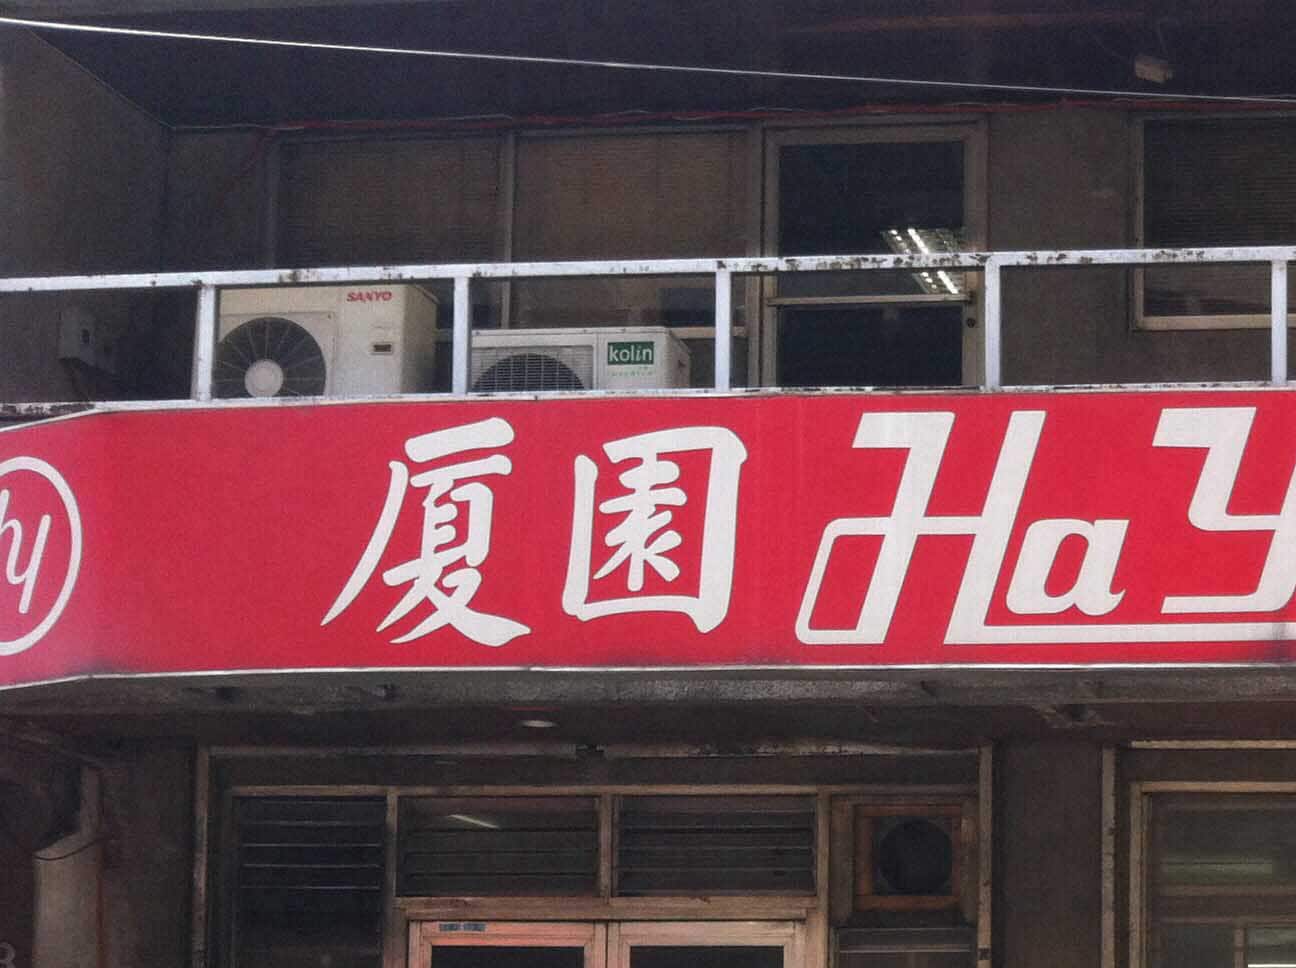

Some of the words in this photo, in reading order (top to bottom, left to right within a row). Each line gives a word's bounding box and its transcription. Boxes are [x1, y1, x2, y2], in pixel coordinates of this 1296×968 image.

[346, 291, 393, 302] SANYO
[609, 344, 652, 362] kolin
[795, 407, 1130, 646] Ha
